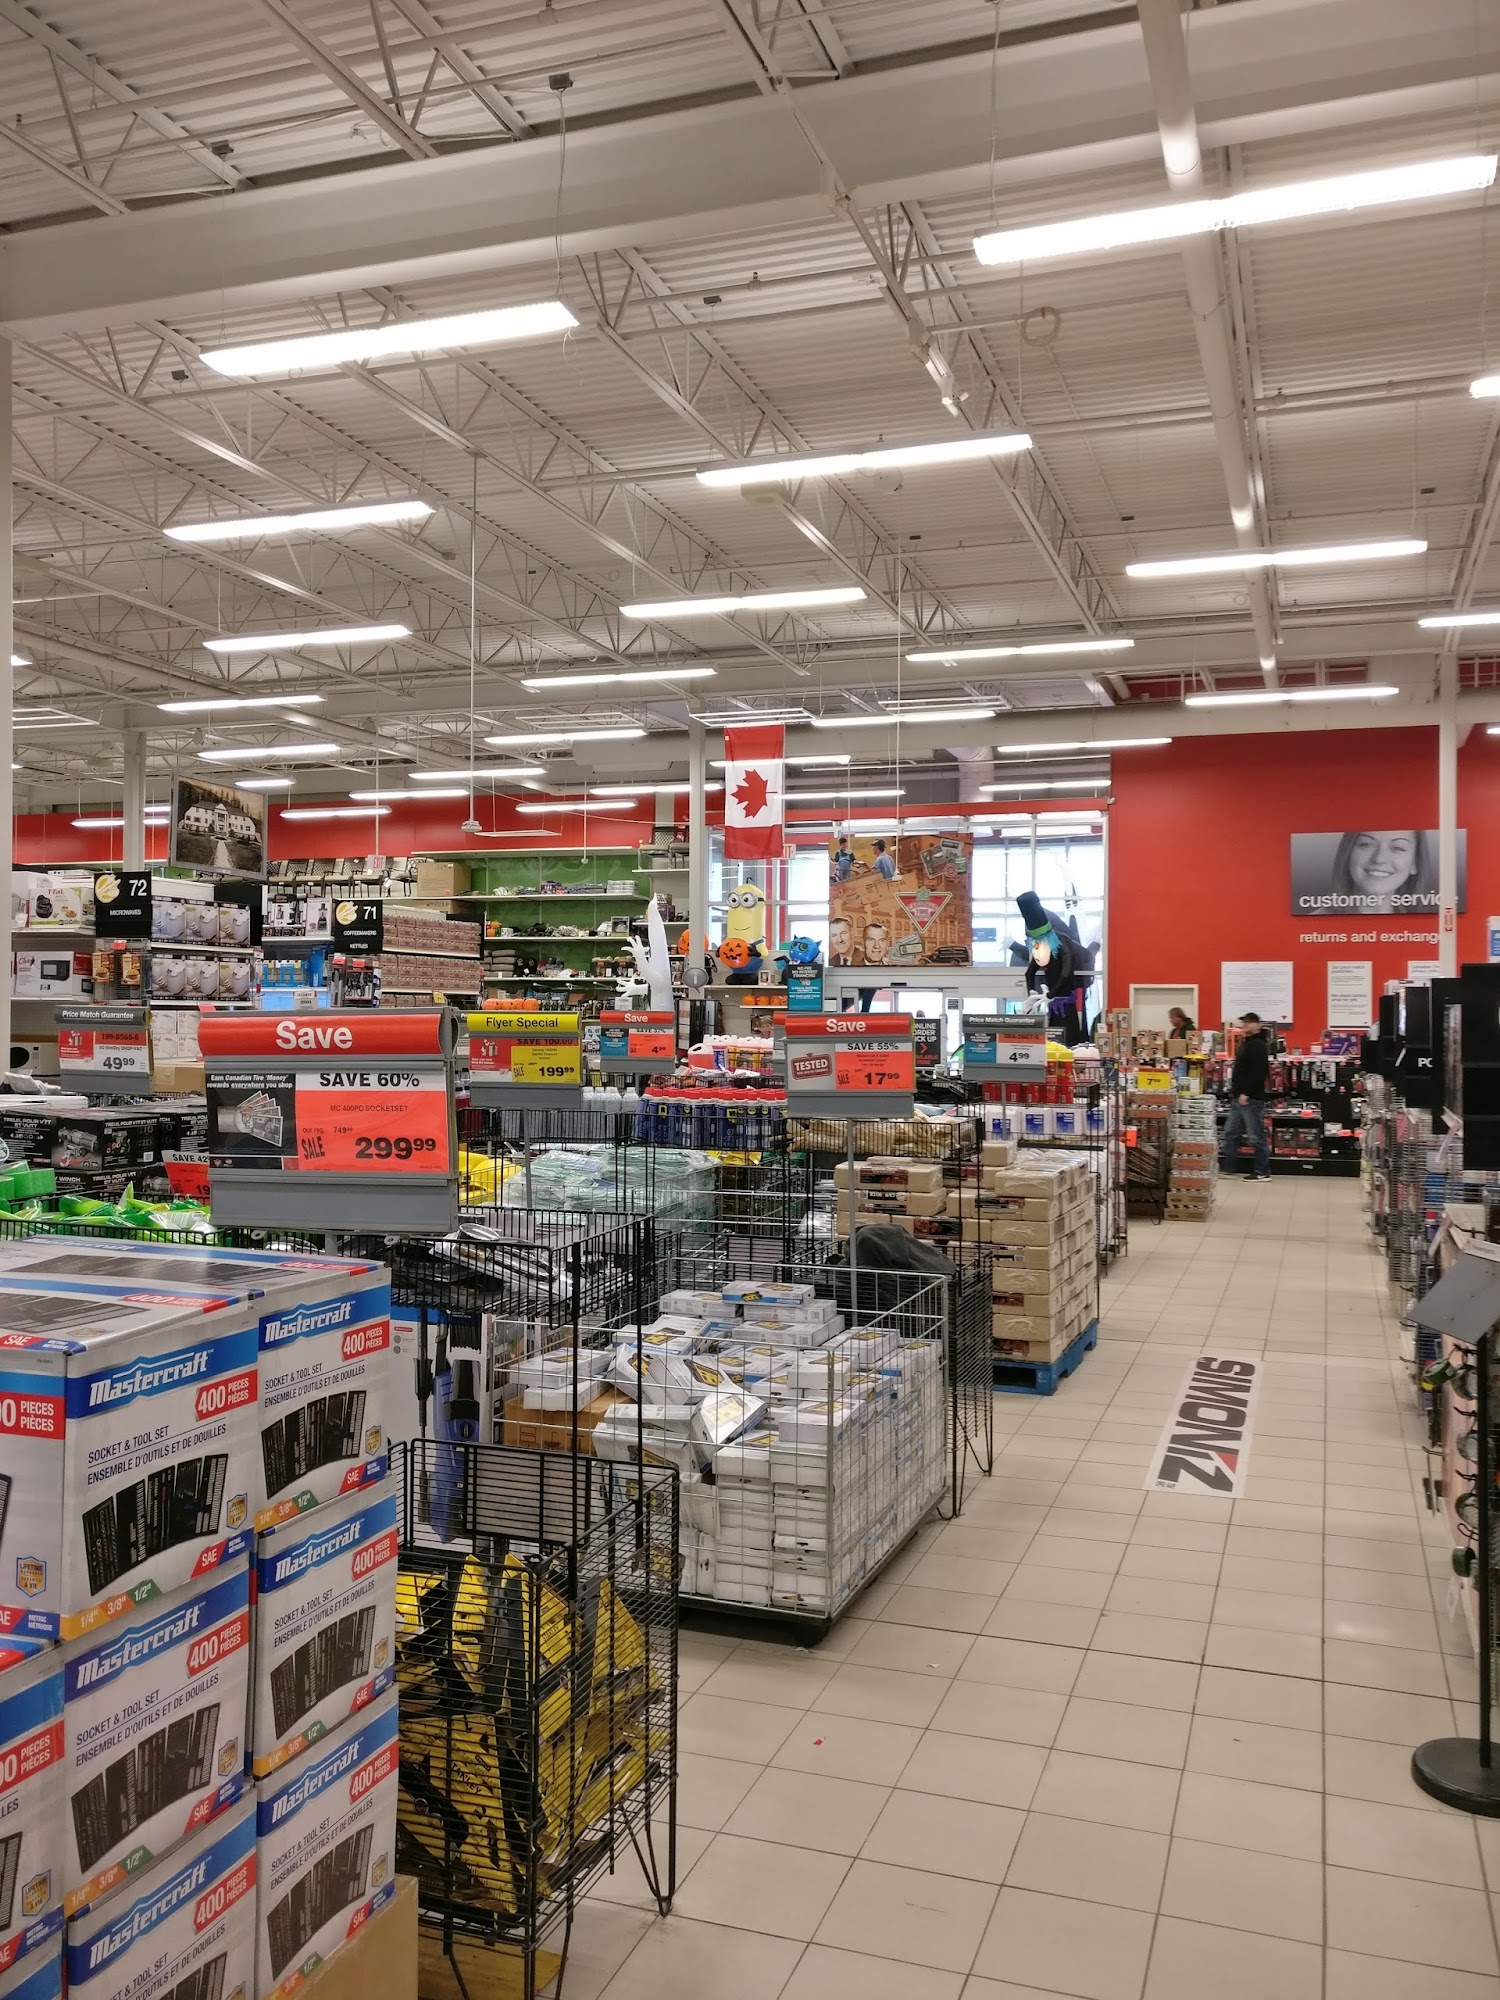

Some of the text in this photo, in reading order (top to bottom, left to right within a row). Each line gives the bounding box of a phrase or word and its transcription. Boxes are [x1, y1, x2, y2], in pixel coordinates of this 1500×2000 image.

[129, 879, 147, 897] 72
[1300, 893, 1385, 908] customer
[363, 906, 377, 920] 71
[1300, 932, 1347, 943] returns
[1350, 931, 1376, 942] and
[62, 1010, 78, 1018] Price
[101, 1011, 134, 1019] Guarantee
[486, 1017, 558, 1029] Flyer Special
[624, 1013, 648, 1022] Save
[275, 1020, 353, 1050] Save
[825, 1018, 866, 1033] Save
[847, 1043, 899, 1051] SAVE 55%
[794, 1059, 828, 1072] TESTED
[320, 1073, 420, 1087] SAVE 60%
[173, 1154, 195, 1162] SAVE
[301, 1136, 325, 1160] SALE
[129, 1294, 175, 1303] 400
[265, 1302, 351, 1343] Mastercraft
[366, 1326, 383, 1340] PIECES
[4, 1335, 31, 1347] SAE
[343, 1333, 364, 1355] 400
[89, 1351, 208, 1407] Mastercraft
[228, 1377, 249, 1393] PIECES
[264, 1362, 323, 1391] SOCKET TOOL SET
[264, 1364, 366, 1408] ENSEMBLE D'OUTILS DOUILLES
[198, 1385, 226, 1413] 400
[228, 1388, 249, 1405] PIÈCES
[20, 1401, 54, 1416] PIECES
[20, 1413, 54, 1432] PIÈCES
[1157, 1356, 1256, 1493] SIMONIZ
[87, 1423, 227, 1485] ENSEMBLE D'OUTILS DOUILLES
[88, 1425, 169, 1464] SOCKET TOOL SET
[347, 1469, 360, 1484] SAE
[201, 1549, 218, 1567] SAE
[275, 1521, 361, 1582] Mastercraft
[354, 1549, 374, 1574] 400
[20, 1563, 43, 1571] LIFETIME
[134, 1583, 152, 1602] 1/2"
[107, 1595, 127, 1615] 3/8"
[274, 1580, 375, 1648] ENSEMBLE DOUILLES
[28, 1614, 47, 1623] METRIC
[28, 1622, 53, 1631] MÉTRIQUE
[274, 1608, 300, 1630] SOCKET
[220, 1621, 241, 1640] PIECES
[77, 1606, 200, 1689] Mastercraft
[190, 1635, 218, 1669] 400
[220, 1632, 241, 1653] PIÈCES
[356, 1688, 369, 1705] SAE
[76, 1688, 160, 1746] SOCKET TOOL SET
[76, 1673, 219, 1767] ENSEMBLE D'OUTILS DOUILLES
[20, 1735, 50, 1760] PIECES
[20, 1746, 50, 1776] PIÈCES
[271, 1740, 360, 1824] Mastercraft
[351, 1767, 373, 1796] 400
[193, 1801, 209, 1822] SAE
[270, 1798, 373, 1891] ENSEMBLE DOUILLES
[271, 1816, 331, 1872] SOCKET TOOL SET
[125, 1849, 144, 1870] 1/2"
[226, 1867, 247, 1889] PIECES
[226, 1878, 247, 1902] PIÈCES
[89, 1861, 207, 1970] Mastercraft
[196, 1888, 225, 1925] 400
[353, 1908, 366, 1928] SAE
[192, 1923, 226, 1960] DOUILLES
[132, 1952, 169, 1989] TOOL SET
